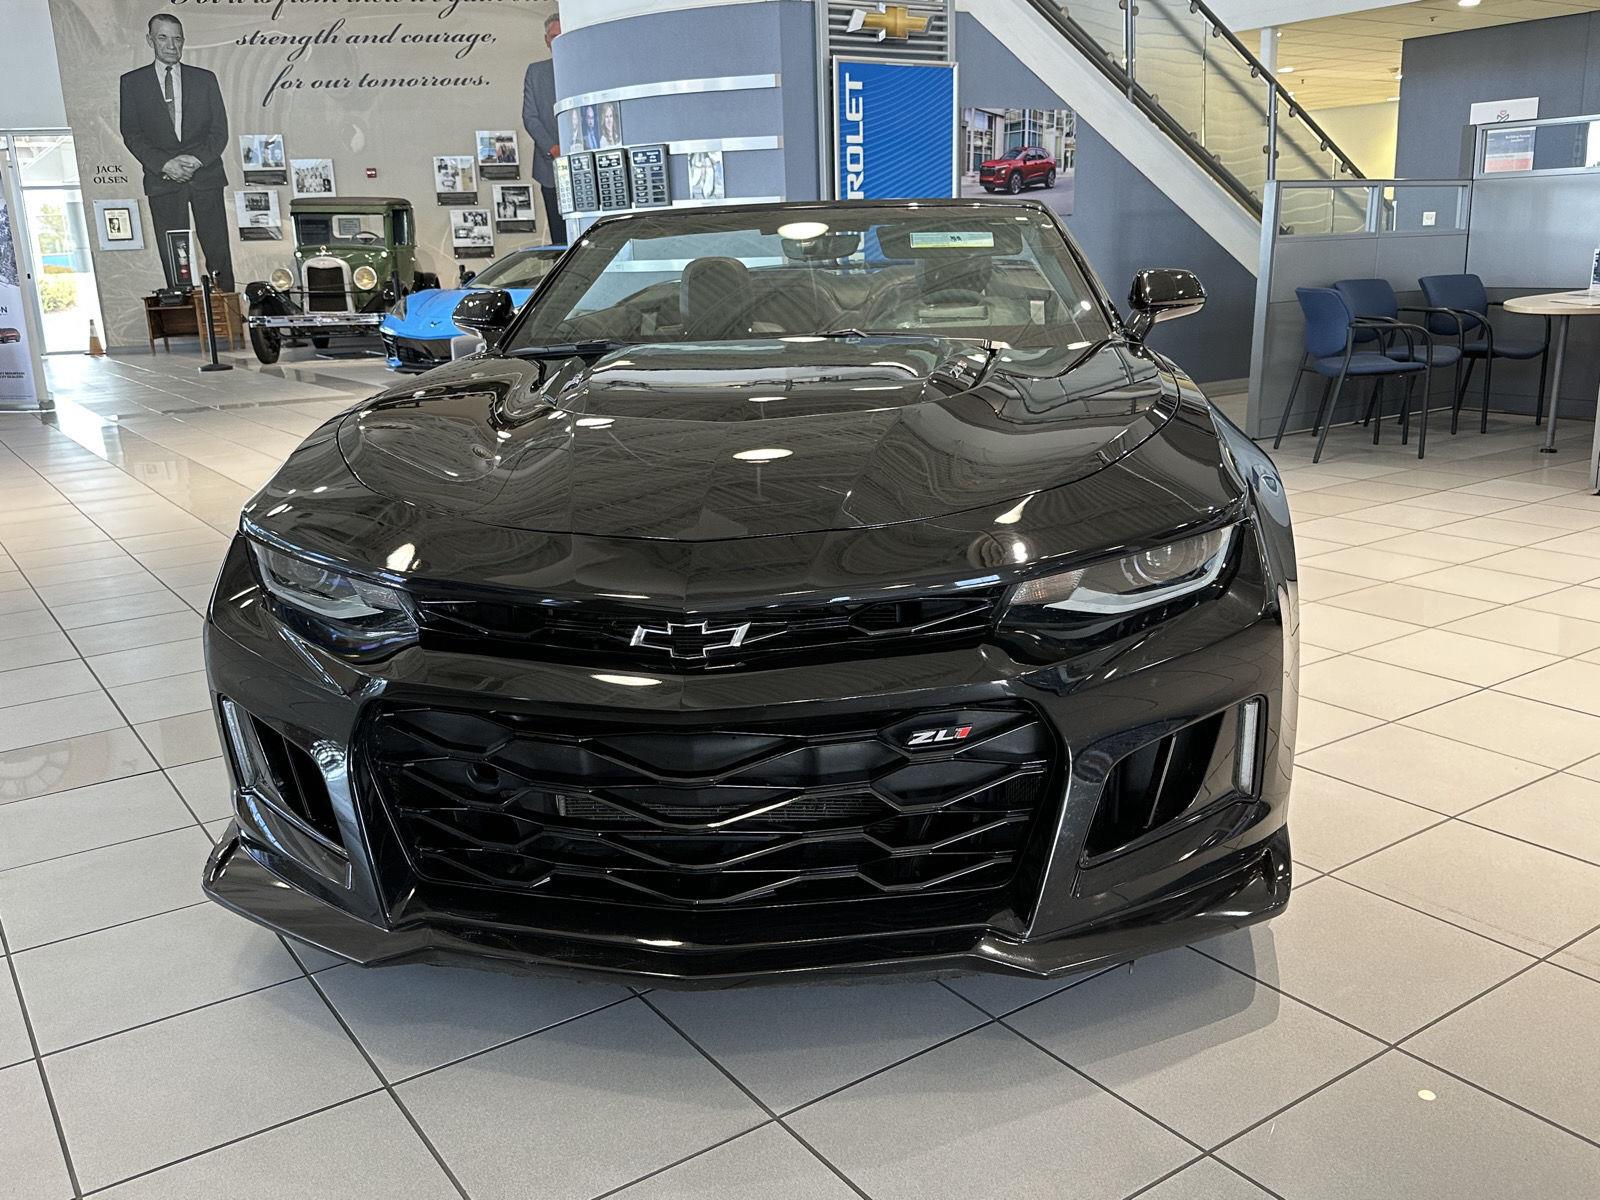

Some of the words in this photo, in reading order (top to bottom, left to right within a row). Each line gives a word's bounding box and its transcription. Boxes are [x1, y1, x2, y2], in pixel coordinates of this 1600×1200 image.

[236, 18, 346, 62] strength
[346, 23, 402, 45] and
[401, 31, 497, 59] courage,
[262, 64, 304, 107] for
[310, 76, 351, 89] our
[357, 73, 491, 89] tomorrows.
[845, 72, 865, 200] ROLET
[93, 176, 128, 184] OLSEN
[96, 165, 123, 174] JACK
[907, 727, 972, 745] ZL1
